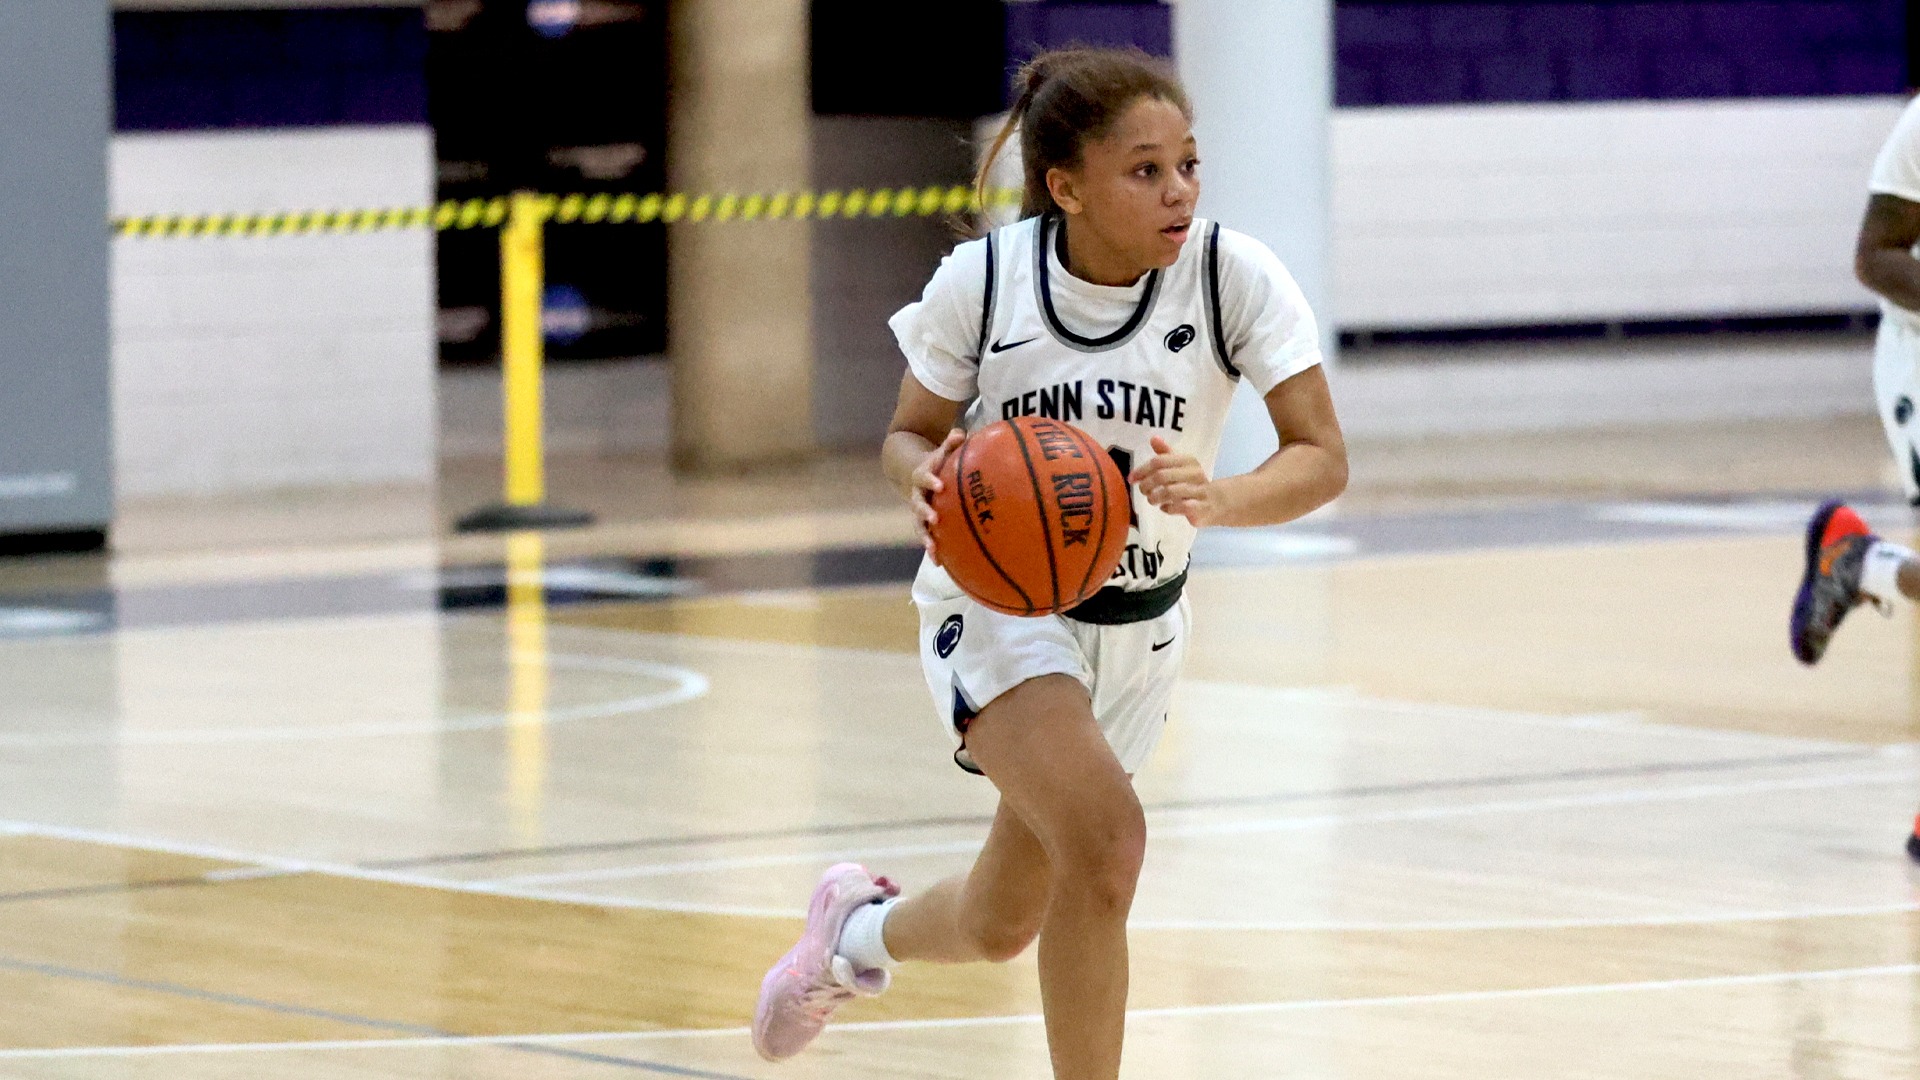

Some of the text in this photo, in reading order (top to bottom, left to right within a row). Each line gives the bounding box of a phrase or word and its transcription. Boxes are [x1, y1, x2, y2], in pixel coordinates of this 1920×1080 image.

[1002, 379, 1187, 432] PENN STATE
[1052, 472, 1093, 549] ROCK
